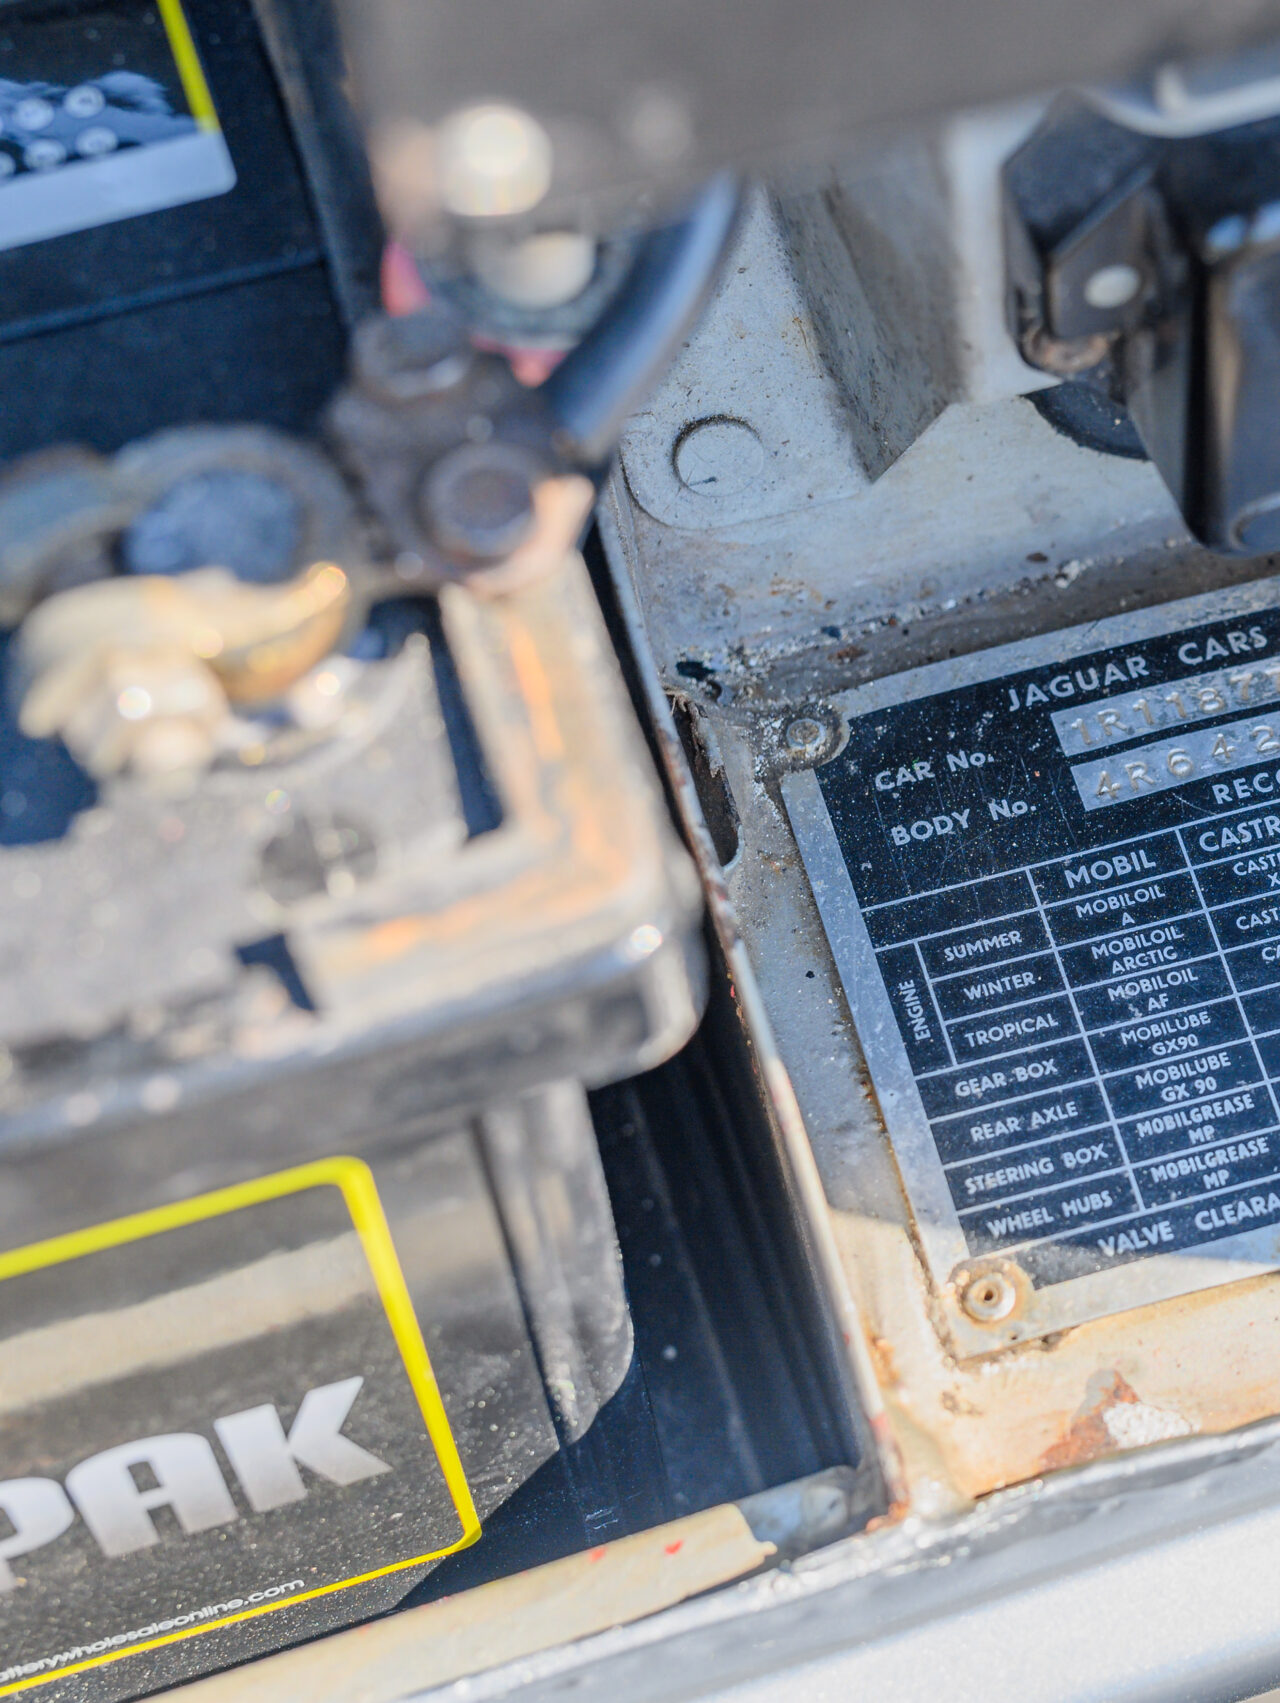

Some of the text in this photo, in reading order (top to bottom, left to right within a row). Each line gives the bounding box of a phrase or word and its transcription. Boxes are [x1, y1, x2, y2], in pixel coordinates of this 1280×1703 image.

[1008, 655, 1149, 711] JAGUAR
[1178, 626, 1267, 665] CARS
[874, 761, 935, 791] CAR
[946, 749, 994, 772] No.
[890, 808, 969, 845] BODY
[987, 798, 1036, 820] No.
[1064, 849, 1156, 888] MOBIL
[1075, 884, 1165, 918] MOBILOIL
[944, 930, 1022, 961] SUMMER
[1091, 926, 1184, 959] MOBILOIL
[1112, 945, 1177, 973] ARCTIC
[963, 971, 1035, 999] WINTER
[1107, 967, 1198, 1001] MOBILOIL
[1148, 992, 1168, 1011] AF
[897, 979, 930, 1040] ENGINE
[1120, 1010, 1210, 1044] MOBILUBE
[964, 1013, 1058, 1047] TROPICAL
[954, 1058, 1057, 1096] GEAR BOX
[1135, 1051, 1231, 1089] MOBILUBE
[970, 1101, 1078, 1141] REAR AXLE
[1136, 1093, 1254, 1137] MOBILGREASE
[1188, 1124, 1214, 1144] MP
[964, 1143, 1108, 1194] STEERING BOX
[1150, 1136, 1269, 1182] MOBILGREASE
[1202, 1169, 1229, 1189] MP
[986, 1190, 1112, 1239] WHEEL HUBS
[1097, 1220, 1174, 1258] VALVE
